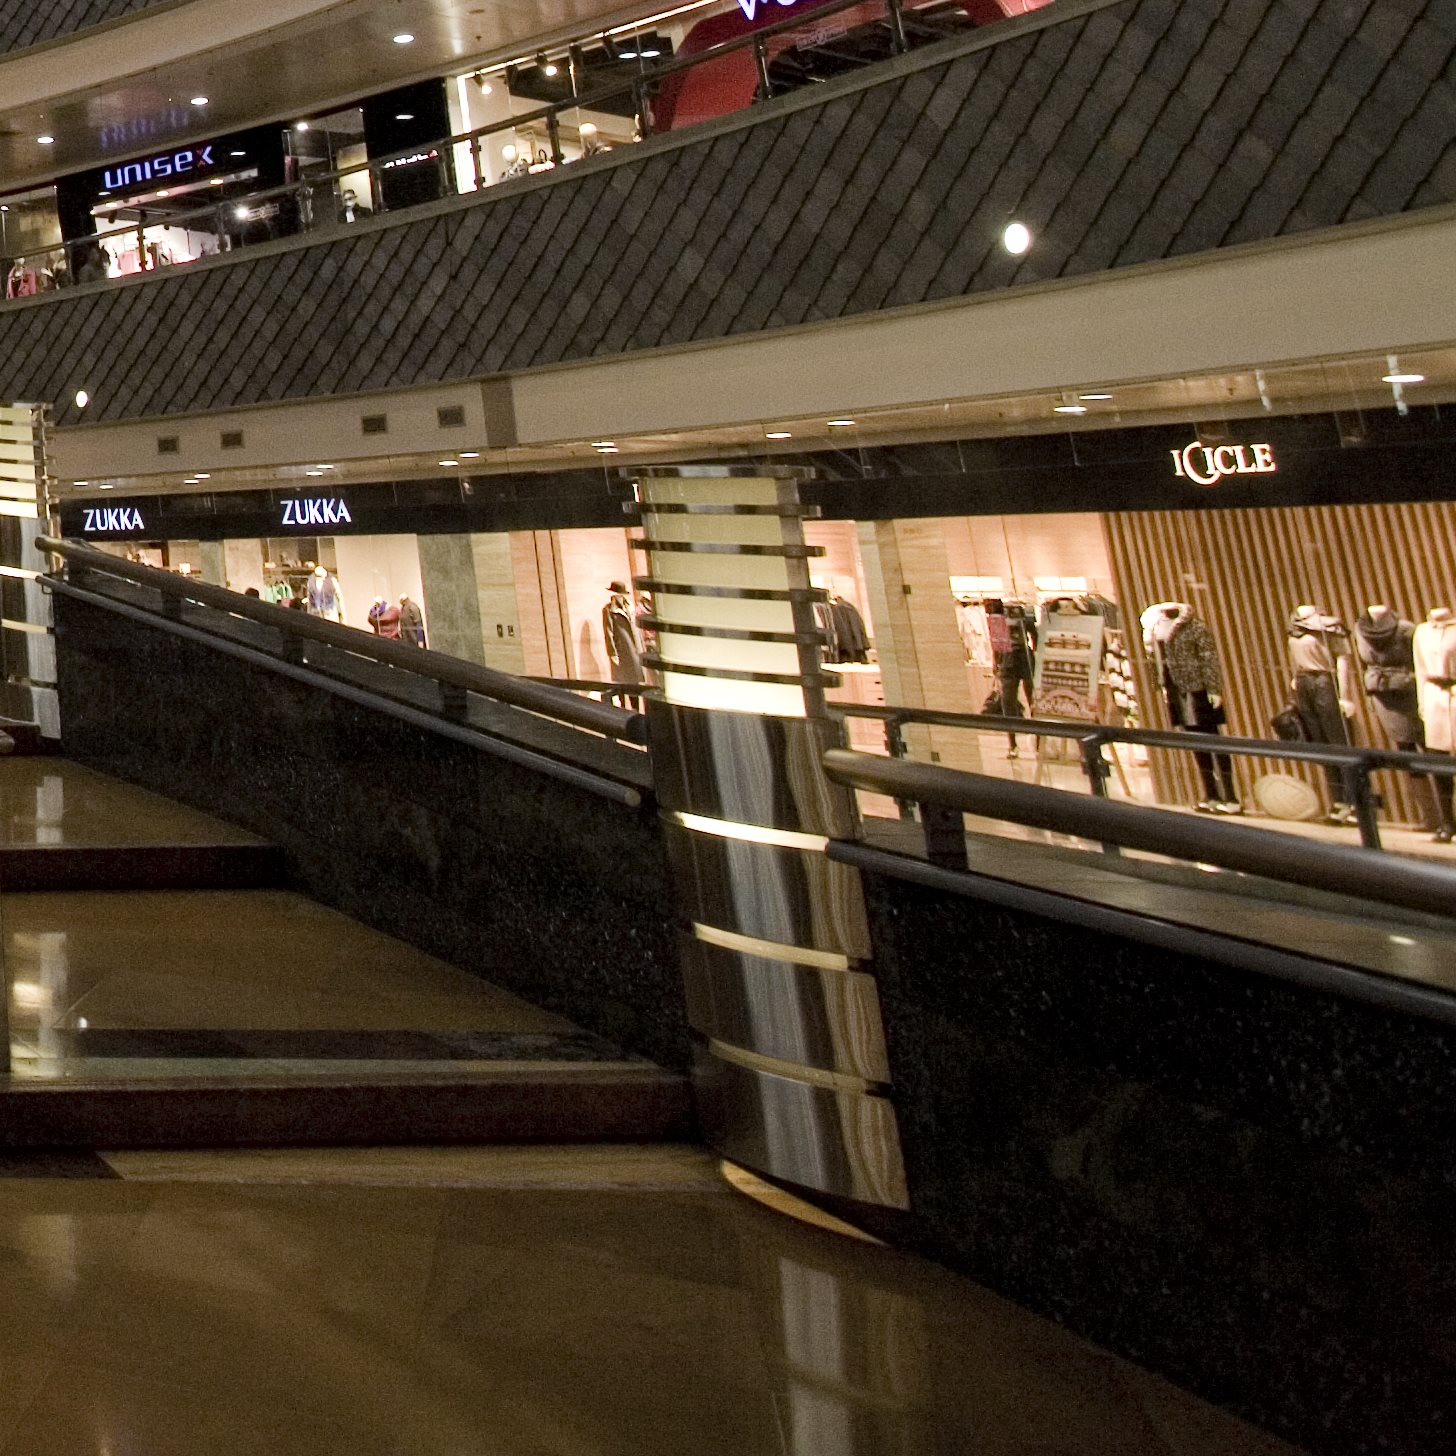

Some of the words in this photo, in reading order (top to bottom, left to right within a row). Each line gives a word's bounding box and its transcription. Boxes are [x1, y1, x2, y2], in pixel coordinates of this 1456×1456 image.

[1169, 440, 1277, 485] ICICLE
[82, 507, 145, 532] ZUKKA
[279, 497, 352, 526] ZUKKA
